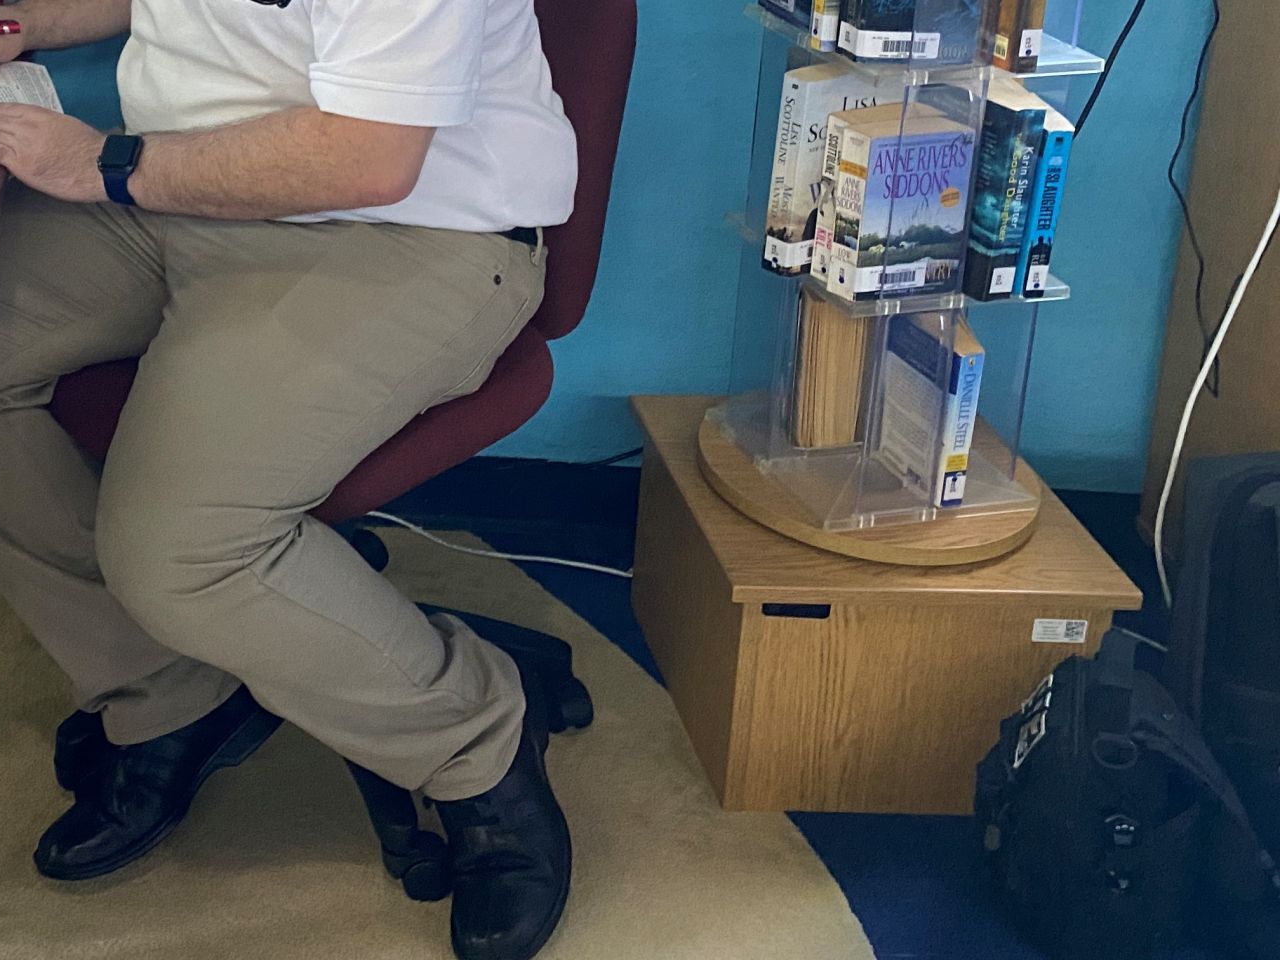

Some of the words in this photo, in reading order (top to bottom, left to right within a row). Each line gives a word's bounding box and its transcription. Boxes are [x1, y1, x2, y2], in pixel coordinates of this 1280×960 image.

[777, 96, 796, 167] SCOTTOLINE
[789, 122, 802, 146] LISA
[825, 133, 839, 178] SCOTTOLINE
[873, 148, 916, 175] ANNE
[917, 144, 968, 171] RIVERS
[1019, 146, 1035, 178] Karin
[883, 170, 950, 200] SIDDONS
[1010, 179, 1029, 229] Slaughter
[1037, 172, 1062, 231] SLAUGHTER
[957, 373, 976, 422] DANIELLE
[953, 422, 969, 452] STEEL
